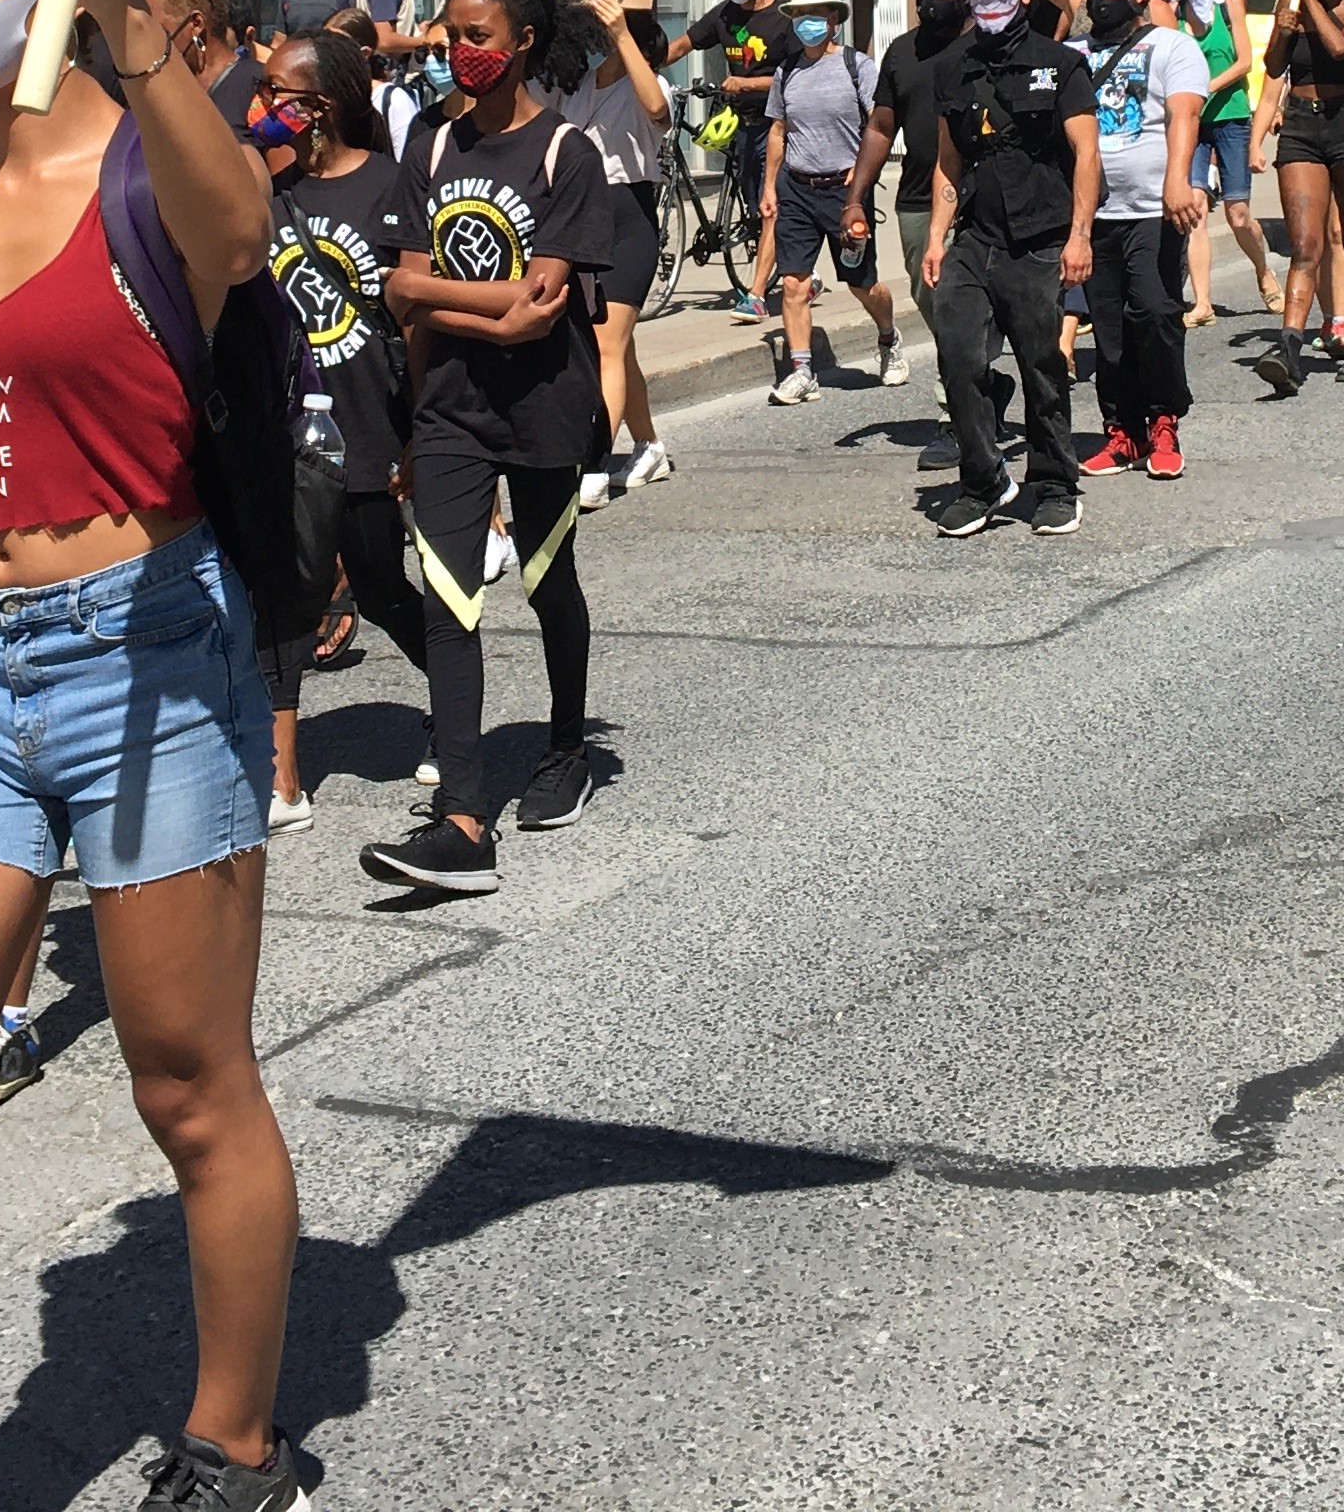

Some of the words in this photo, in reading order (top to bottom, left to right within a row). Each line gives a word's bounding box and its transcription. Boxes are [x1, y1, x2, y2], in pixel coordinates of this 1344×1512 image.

[280, 216, 329, 243] CIL
[332, 223, 380, 296] RIGHTS
[440, 178, 493, 203] CIVIL
[494, 185, 536, 262] RIGHS
